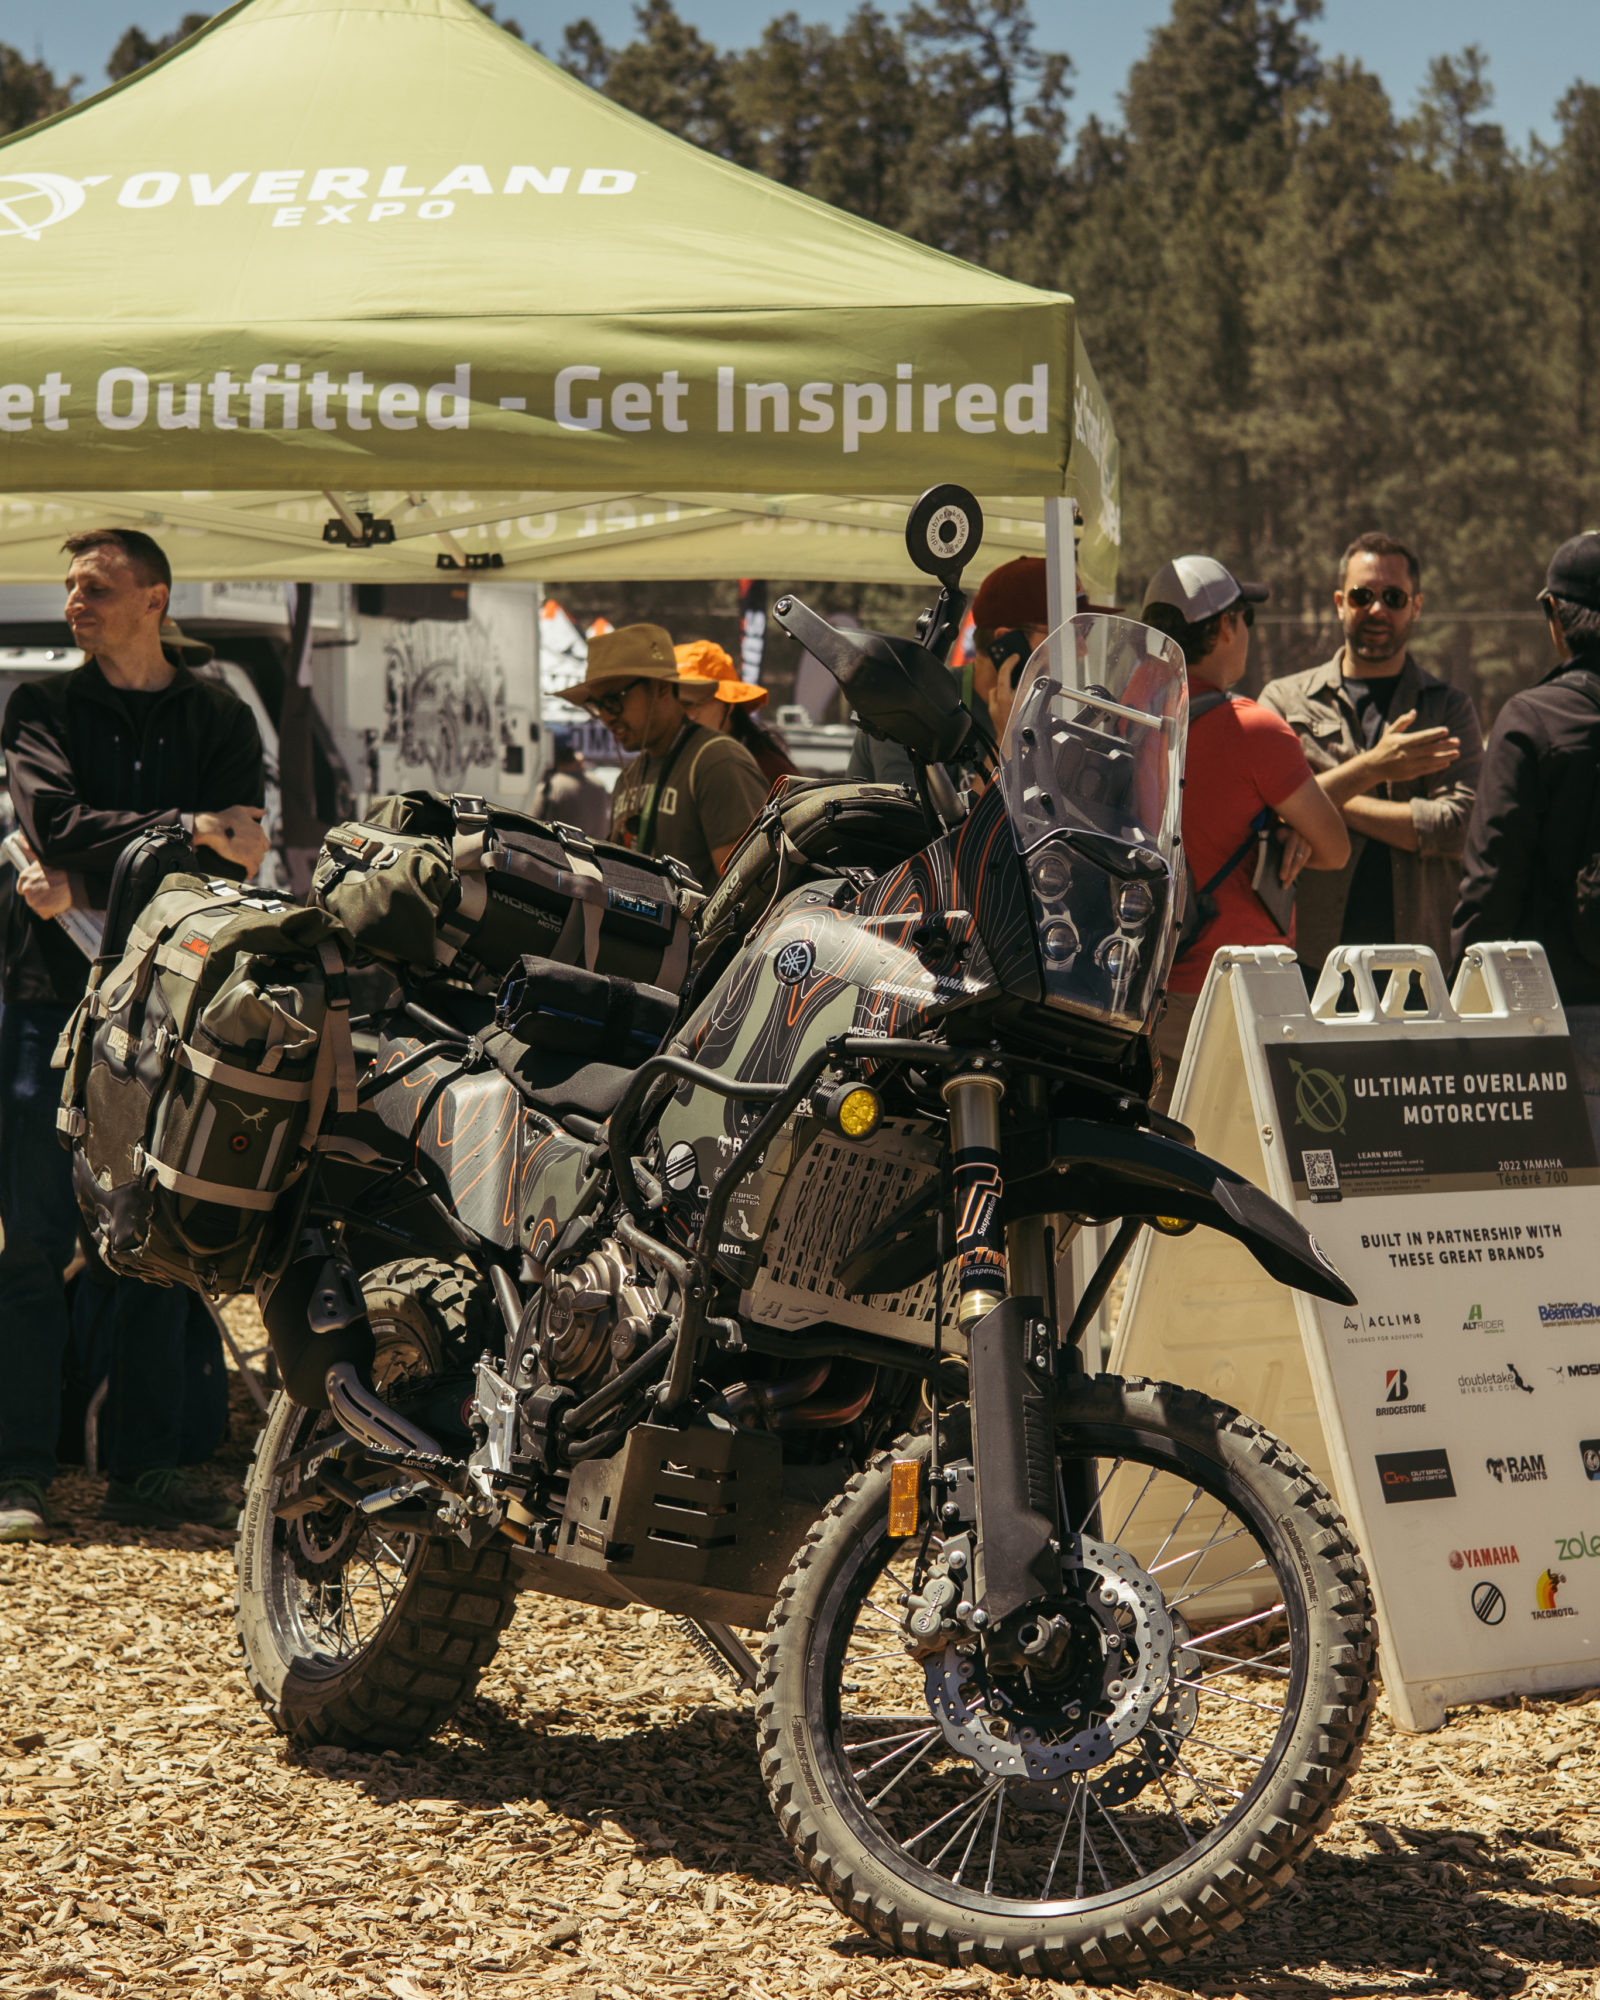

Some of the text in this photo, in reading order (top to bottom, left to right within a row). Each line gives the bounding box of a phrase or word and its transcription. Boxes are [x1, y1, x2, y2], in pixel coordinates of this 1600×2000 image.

[117, 165, 638, 208] OVERLAND
[271, 201, 455, 228] EXPO
[0, 372, 70, 431] et
[96, 363, 471, 432] Outfitted
[554, 366, 689, 432] Get
[717, 363, 1049, 453] Inspired
[491, 889, 563, 926] MOSKO
[702, 871, 740, 935] MOSKO
[871, 980, 950, 1004] BRIDGESTONE
[935, 975, 983, 996] YAMAHA
[847, 1026, 888, 1039] MOSKO
[1354, 1072, 1567, 1098] ULTIMATE OVERLAND
[1403, 1101, 1534, 1125] MOTORCYCLE
[1357, 1150, 1403, 1159] LEARN MORE
[1498, 1159, 1563, 1171] 2022 YAMAHA
[1497, 1171, 1568, 1187] Ténéré 700
[977, 1197, 997, 1236] Suspension
[1361, 1224, 1562, 1249] BUILT IN PARTNERSHIP WITH
[1389, 1246, 1545, 1268] THESE GREAT BRANDS
[1368, 1313, 1421, 1328] ACLIM8
[1462, 1319, 1504, 1331] ALTRIDER
[1391, 1333, 1423, 1341] ADVENTURE
[1458, 1372, 1514, 1387] doubletake
[1567, 1364, 1600, 1377] MOS
[1376, 1404, 1426, 1416] BRIDGESTONE
[401, 1459, 436, 1471] ALTRIDER
[1411, 1468, 1447, 1476] OUTBACK
[1507, 1454, 1546, 1473] RAM
[1510, 1471, 1548, 1483] MOUNTS
[243, 1491, 262, 1593] BRIDGESTONE
[1282, 1517, 1319, 1604] BRIDGESTONE
[1463, 1545, 1520, 1568] YAMAHA
[1531, 1607, 1574, 1620] TACOMOTO
[793, 1721, 827, 1807] BRIDGESTONE
